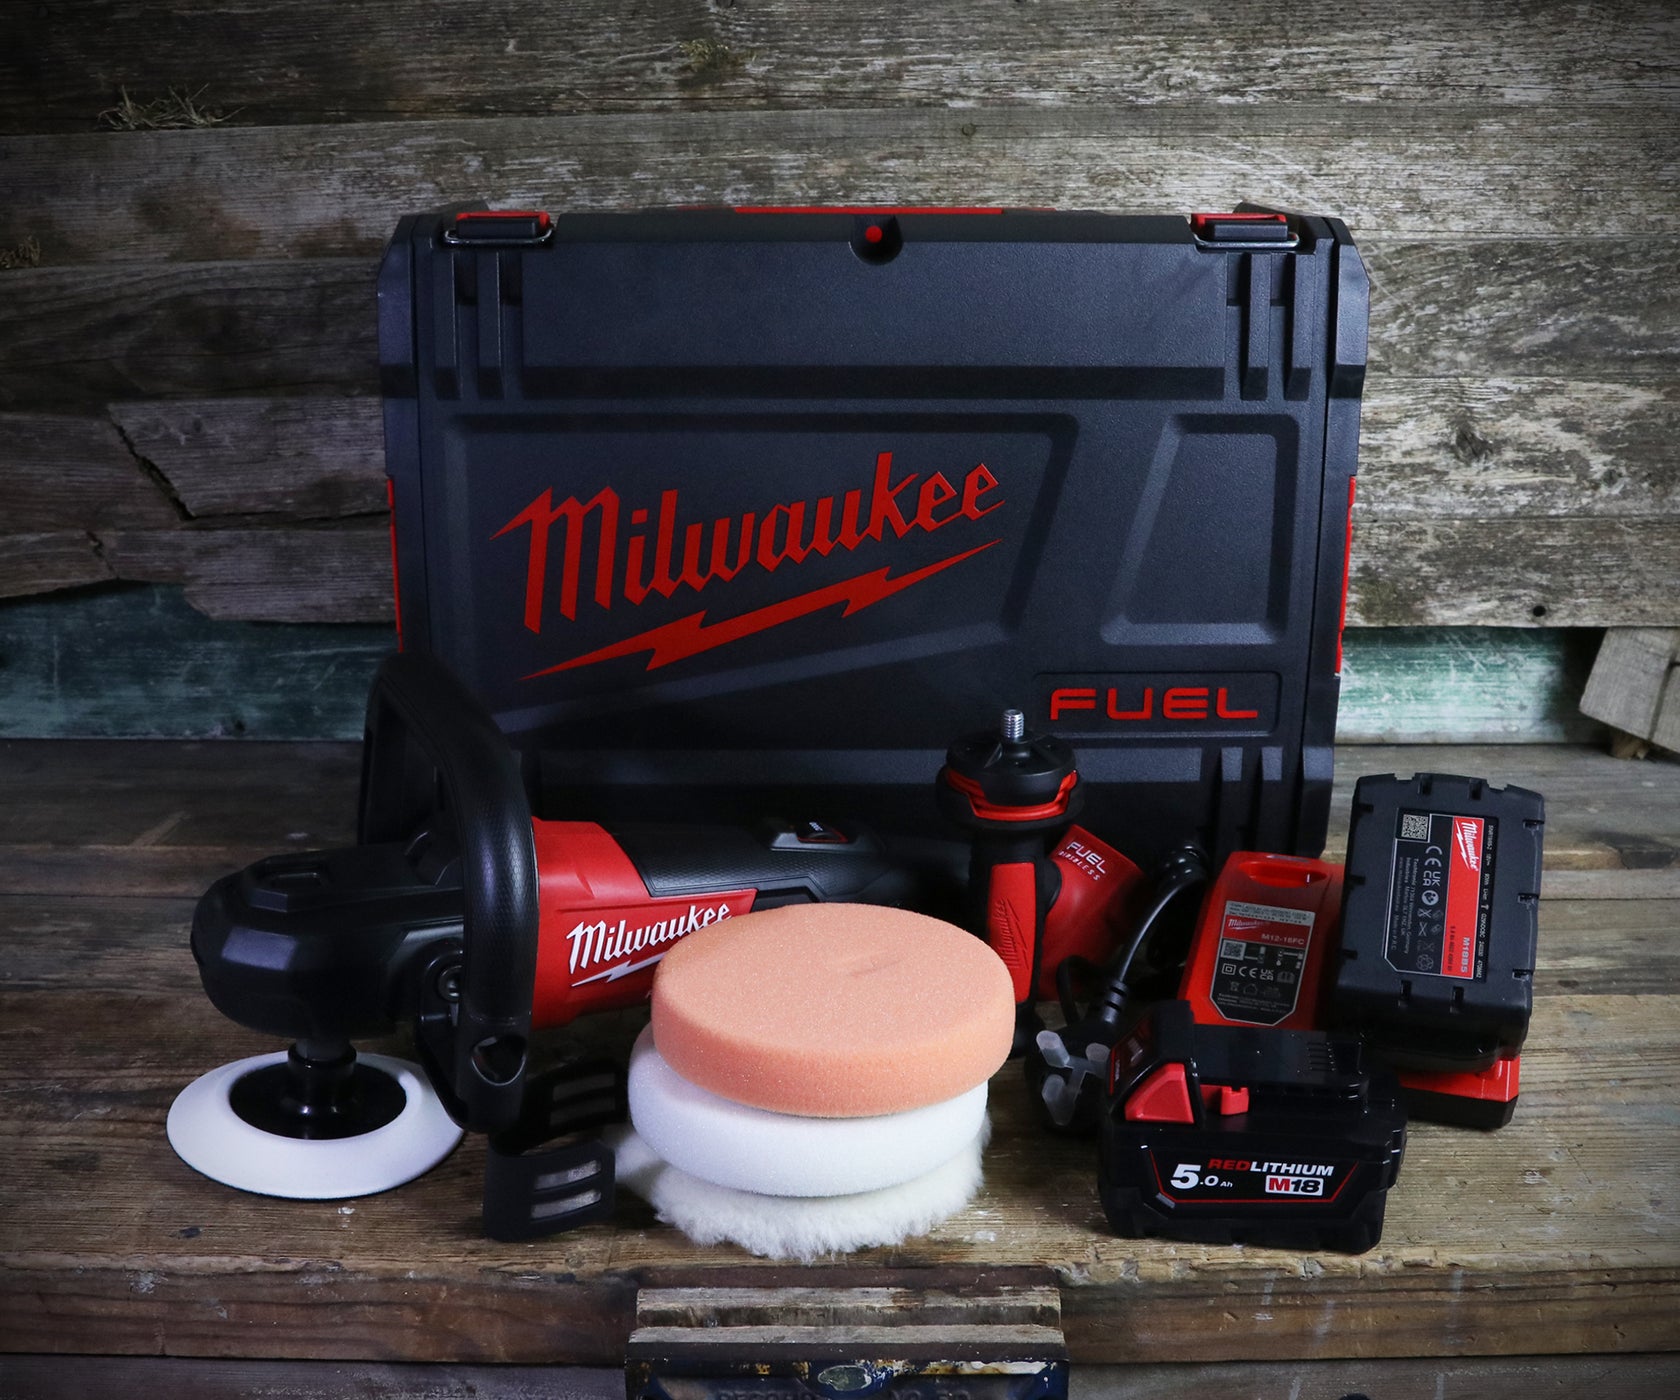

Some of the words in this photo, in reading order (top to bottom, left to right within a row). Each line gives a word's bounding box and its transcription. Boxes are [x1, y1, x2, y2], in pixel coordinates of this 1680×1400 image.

[490, 452, 1005, 634] Milwaukee
[1050, 686, 1259, 720] FUEL
[1066, 841, 1106, 874] FUEL
[1461, 821, 1480, 869] Milwaukee
[1422, 870, 1432, 886] CA
[1431, 871, 1441, 886] UK
[566, 903, 732, 974] Milwaukee
[1208, 1158, 1334, 1177] REDLITHIUM
[1268, 1177, 1321, 1194] M18
